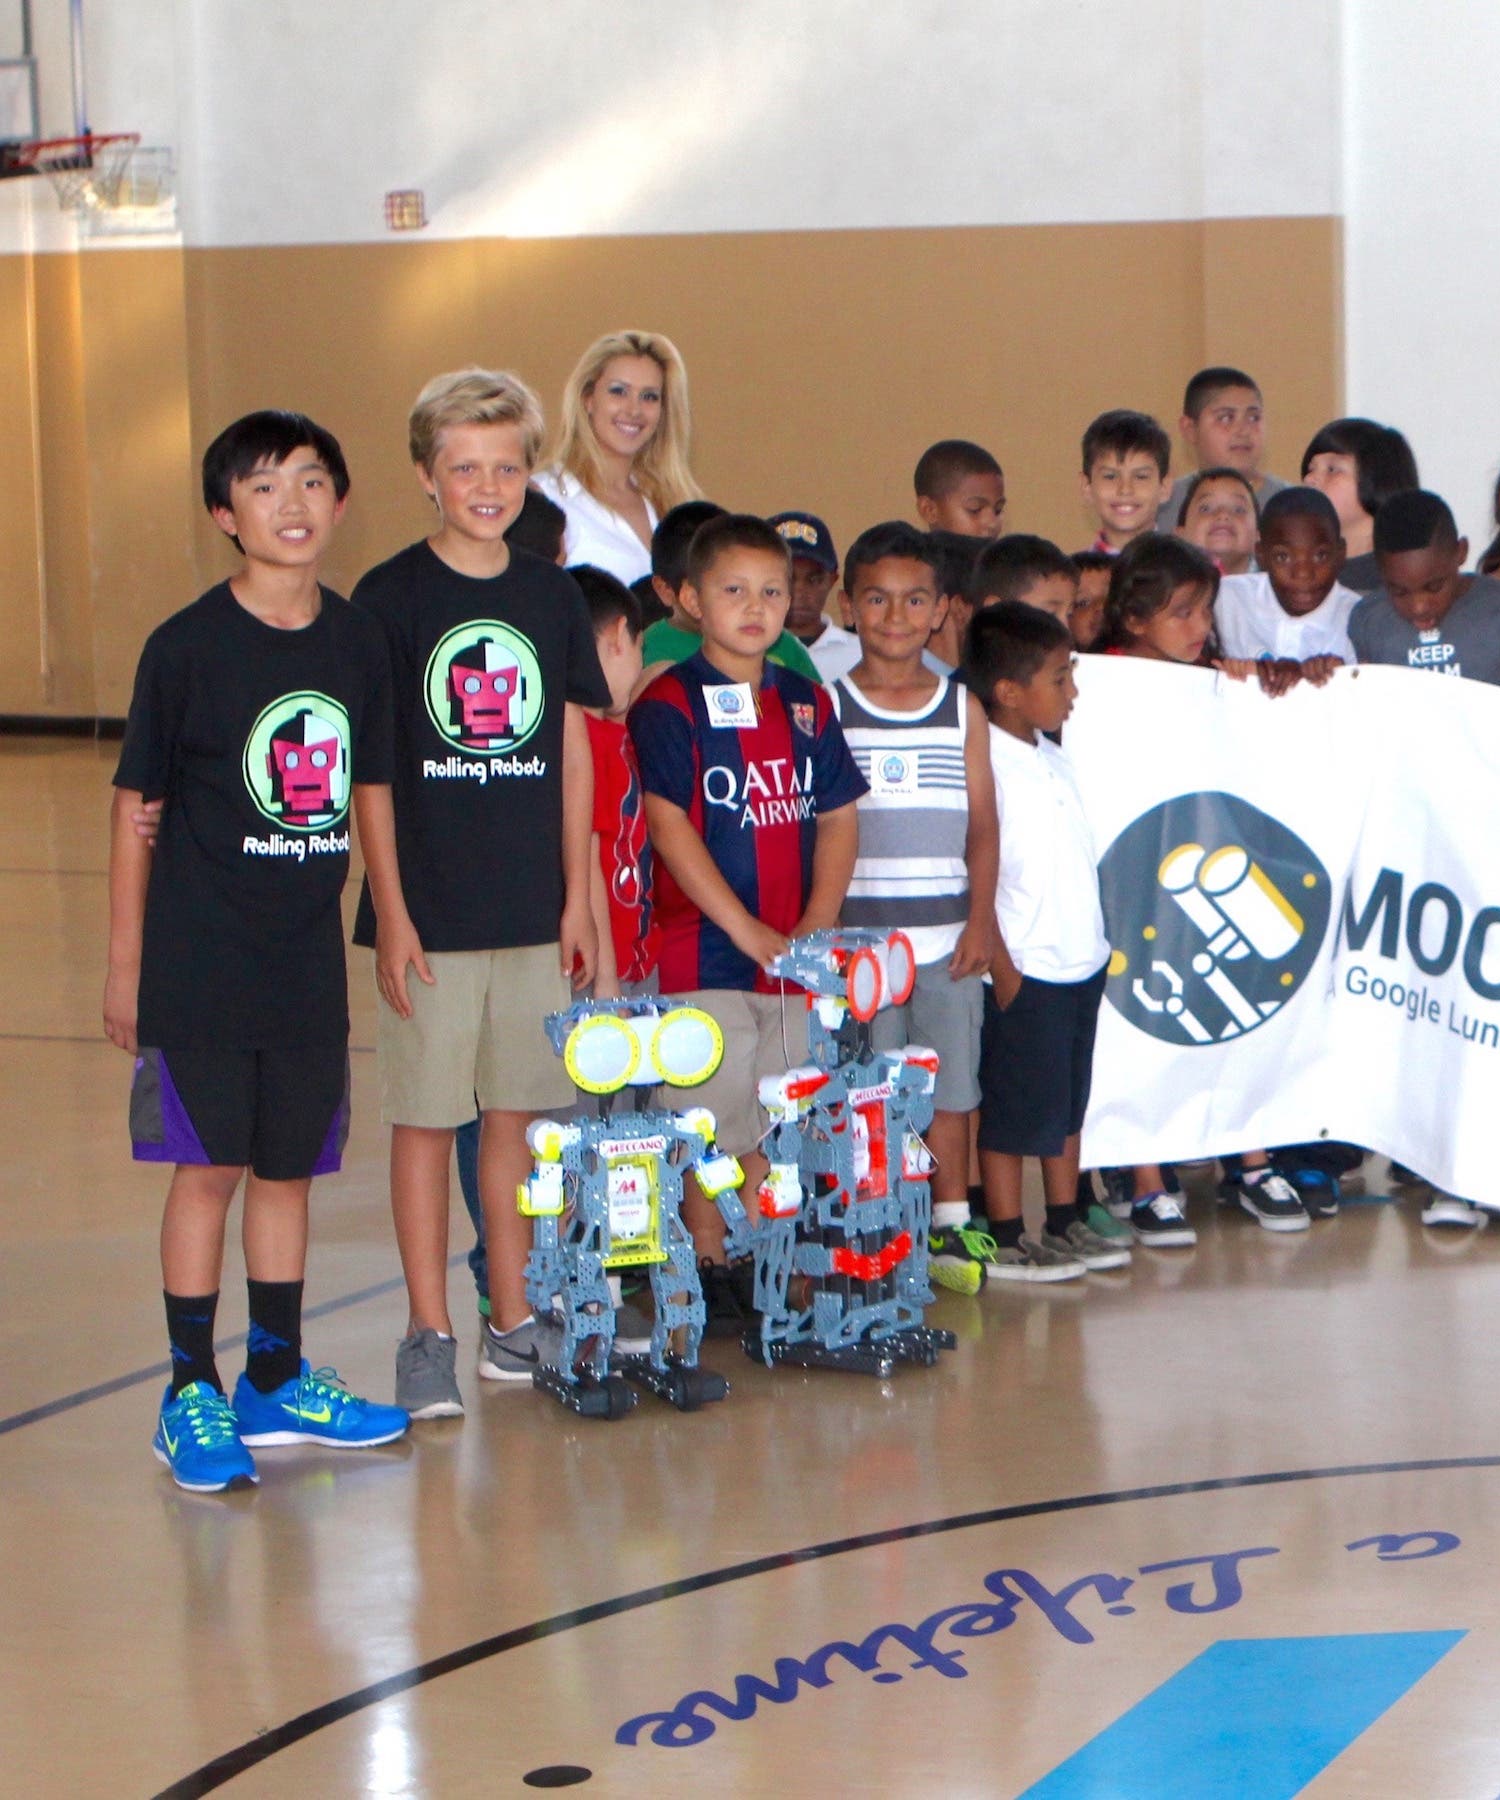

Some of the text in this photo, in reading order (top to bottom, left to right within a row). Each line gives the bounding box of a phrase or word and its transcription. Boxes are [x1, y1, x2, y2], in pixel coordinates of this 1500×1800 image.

[1408, 644, 1454, 665] KEEP
[422, 756, 546, 784] Rolling Robots
[243, 830, 350, 862] Rolling Robot
[1346, 966, 1441, 1022] Google
[607, 1139, 663, 1153] MECCANO
[1345, 1530, 1461, 1561] a
[615, 1546, 1281, 1748] Lifetime
